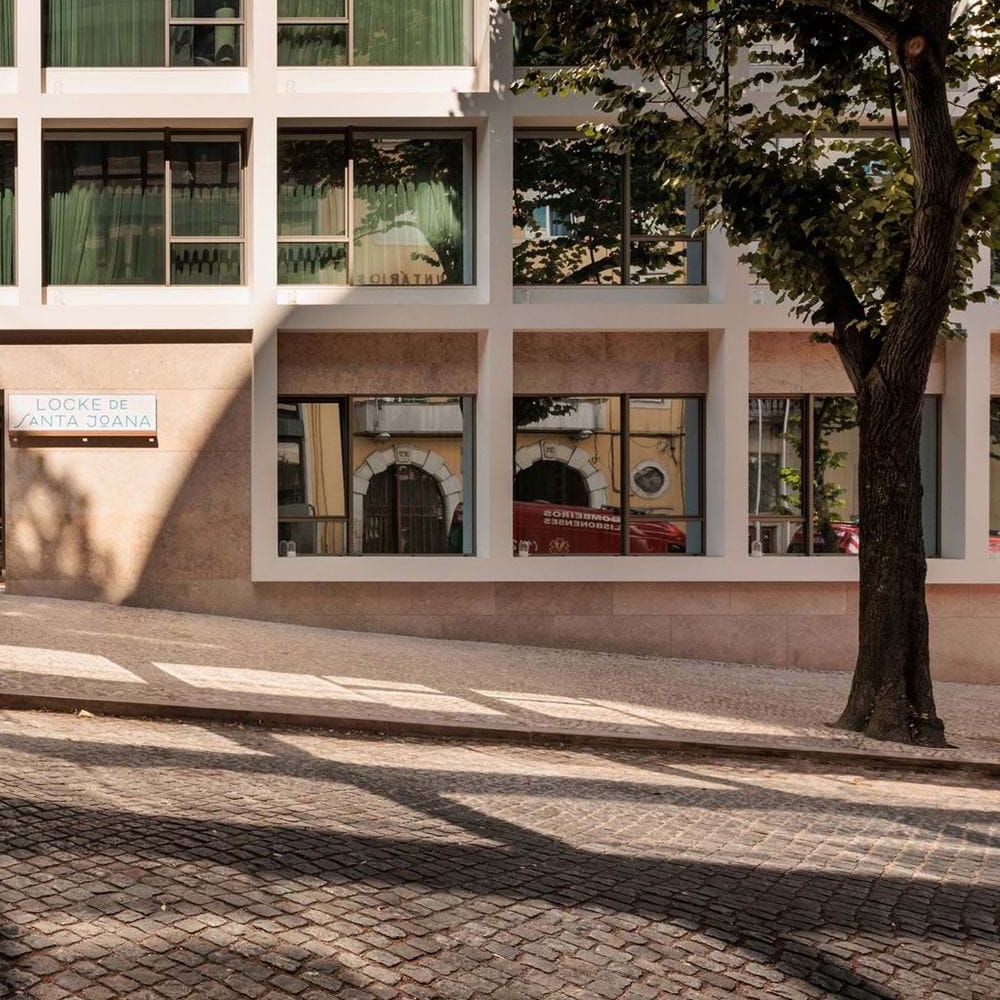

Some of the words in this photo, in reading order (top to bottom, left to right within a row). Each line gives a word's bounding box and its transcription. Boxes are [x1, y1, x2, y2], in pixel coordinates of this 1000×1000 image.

[36, 398, 102, 411] LOCKE
[109, 399, 128, 410] DE
[13, 413, 79, 429] SANTA
[86, 415, 151, 428] JOANA
